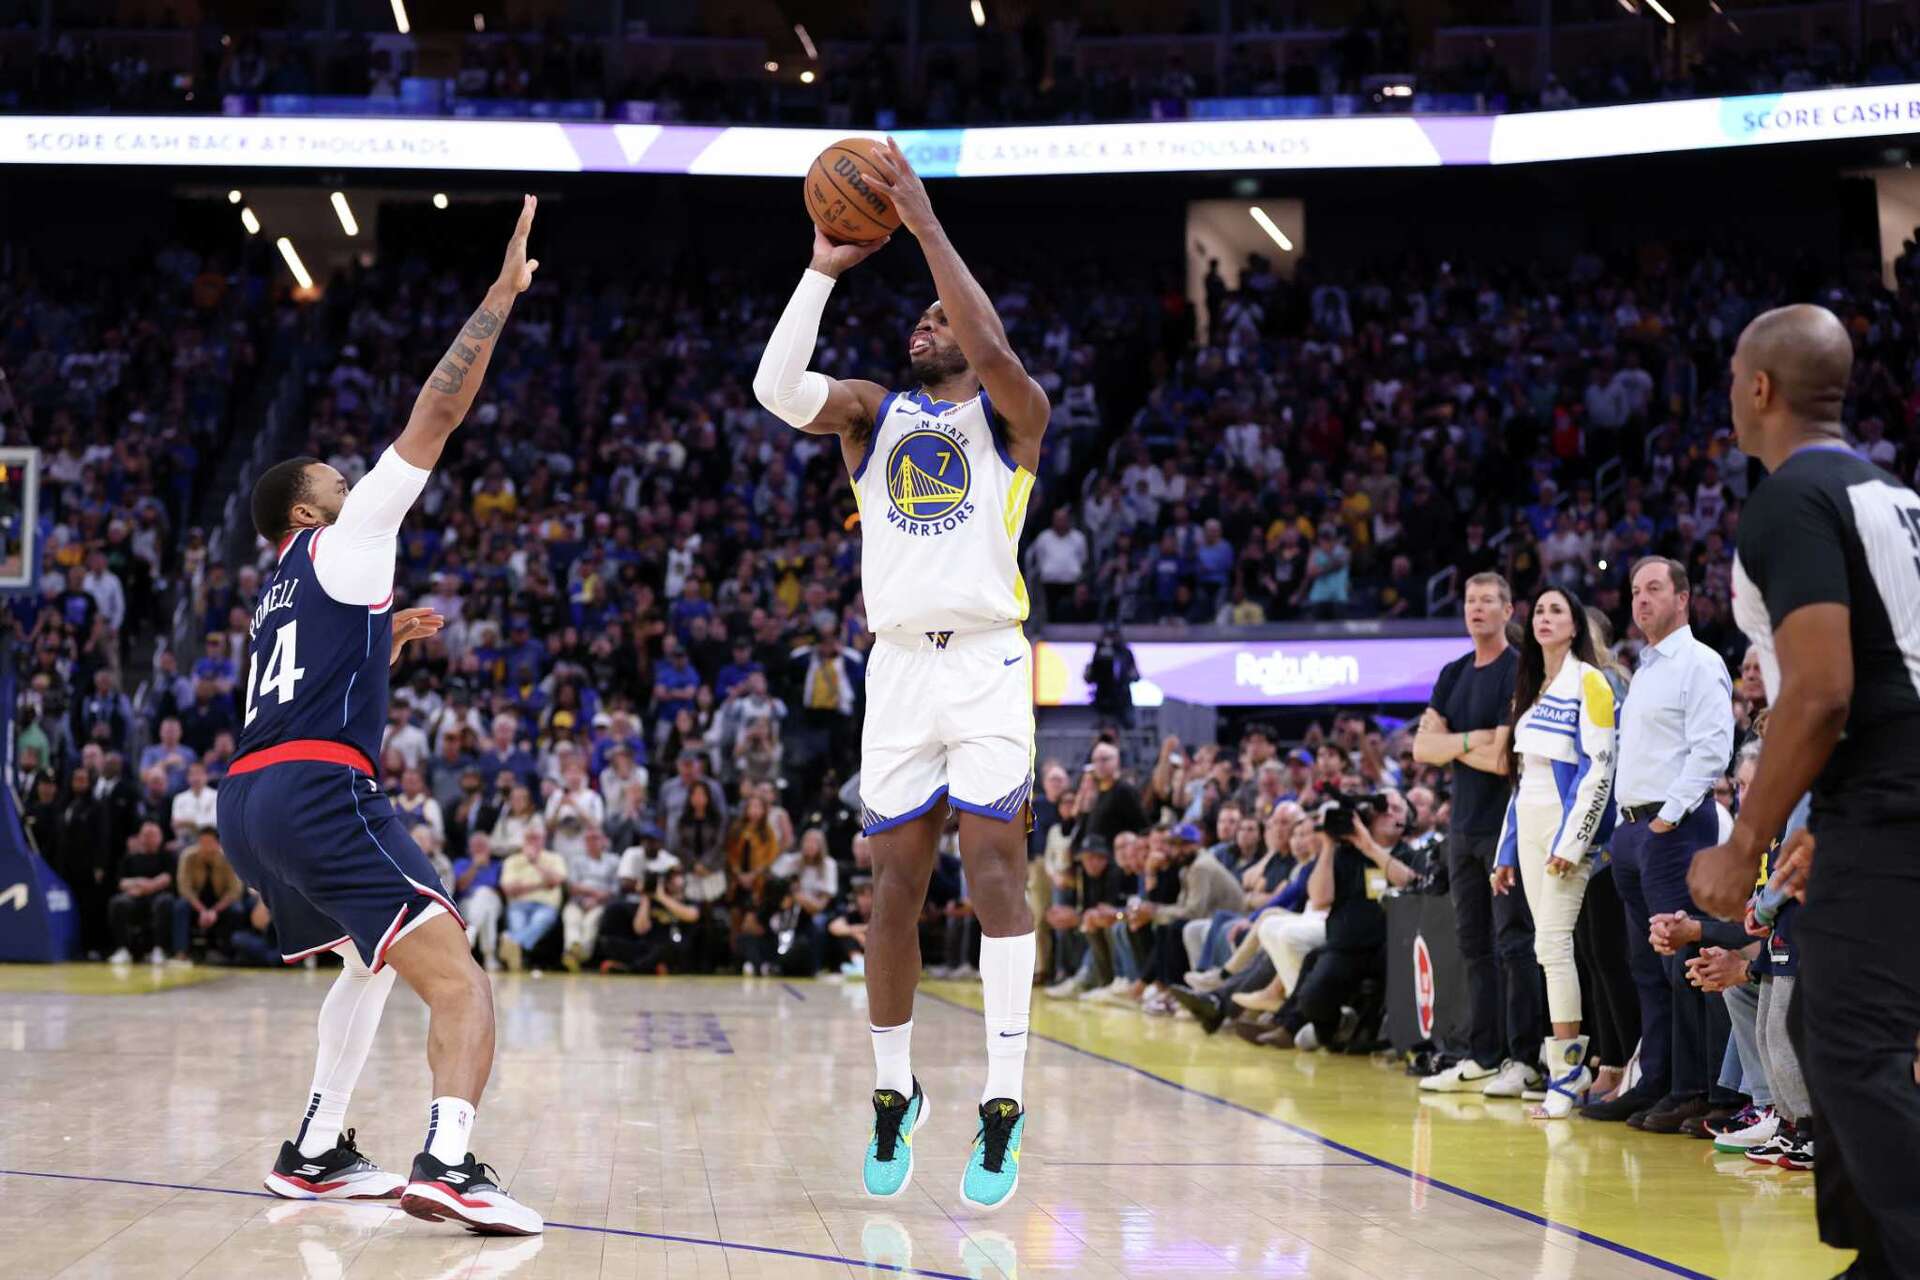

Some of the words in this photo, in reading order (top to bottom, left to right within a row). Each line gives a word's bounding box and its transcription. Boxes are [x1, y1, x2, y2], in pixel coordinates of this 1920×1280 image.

[1742, 107, 1824, 132] SCORE
[1833, 101, 1900, 125] CASH
[26, 132, 106, 151] SCORE
[114, 133, 180, 151] CASH
[188, 134, 247, 152] BACK
[260, 135, 288, 152] AT
[298, 136, 449, 155] THOUSANDS
[902, 143, 962, 165] CORE
[975, 142, 1039, 162] CASH
[1048, 141, 1107, 161] BACK
[1122, 139, 1149, 157] AT
[1157, 136, 1310, 157] THOUSANDS
[834, 155, 887, 215] Wilson
[935, 422, 970, 448] STATE
[935, 451, 952, 477] 7
[886, 501, 975, 536] WARRIORS
[249, 577, 299, 641] POWELL
[244, 619, 306, 729] 14
[1235, 650, 1359, 689] Rakuten
[1532, 704, 1577, 724] CHAMPS
[1576, 778, 1611, 843] WINNERS
